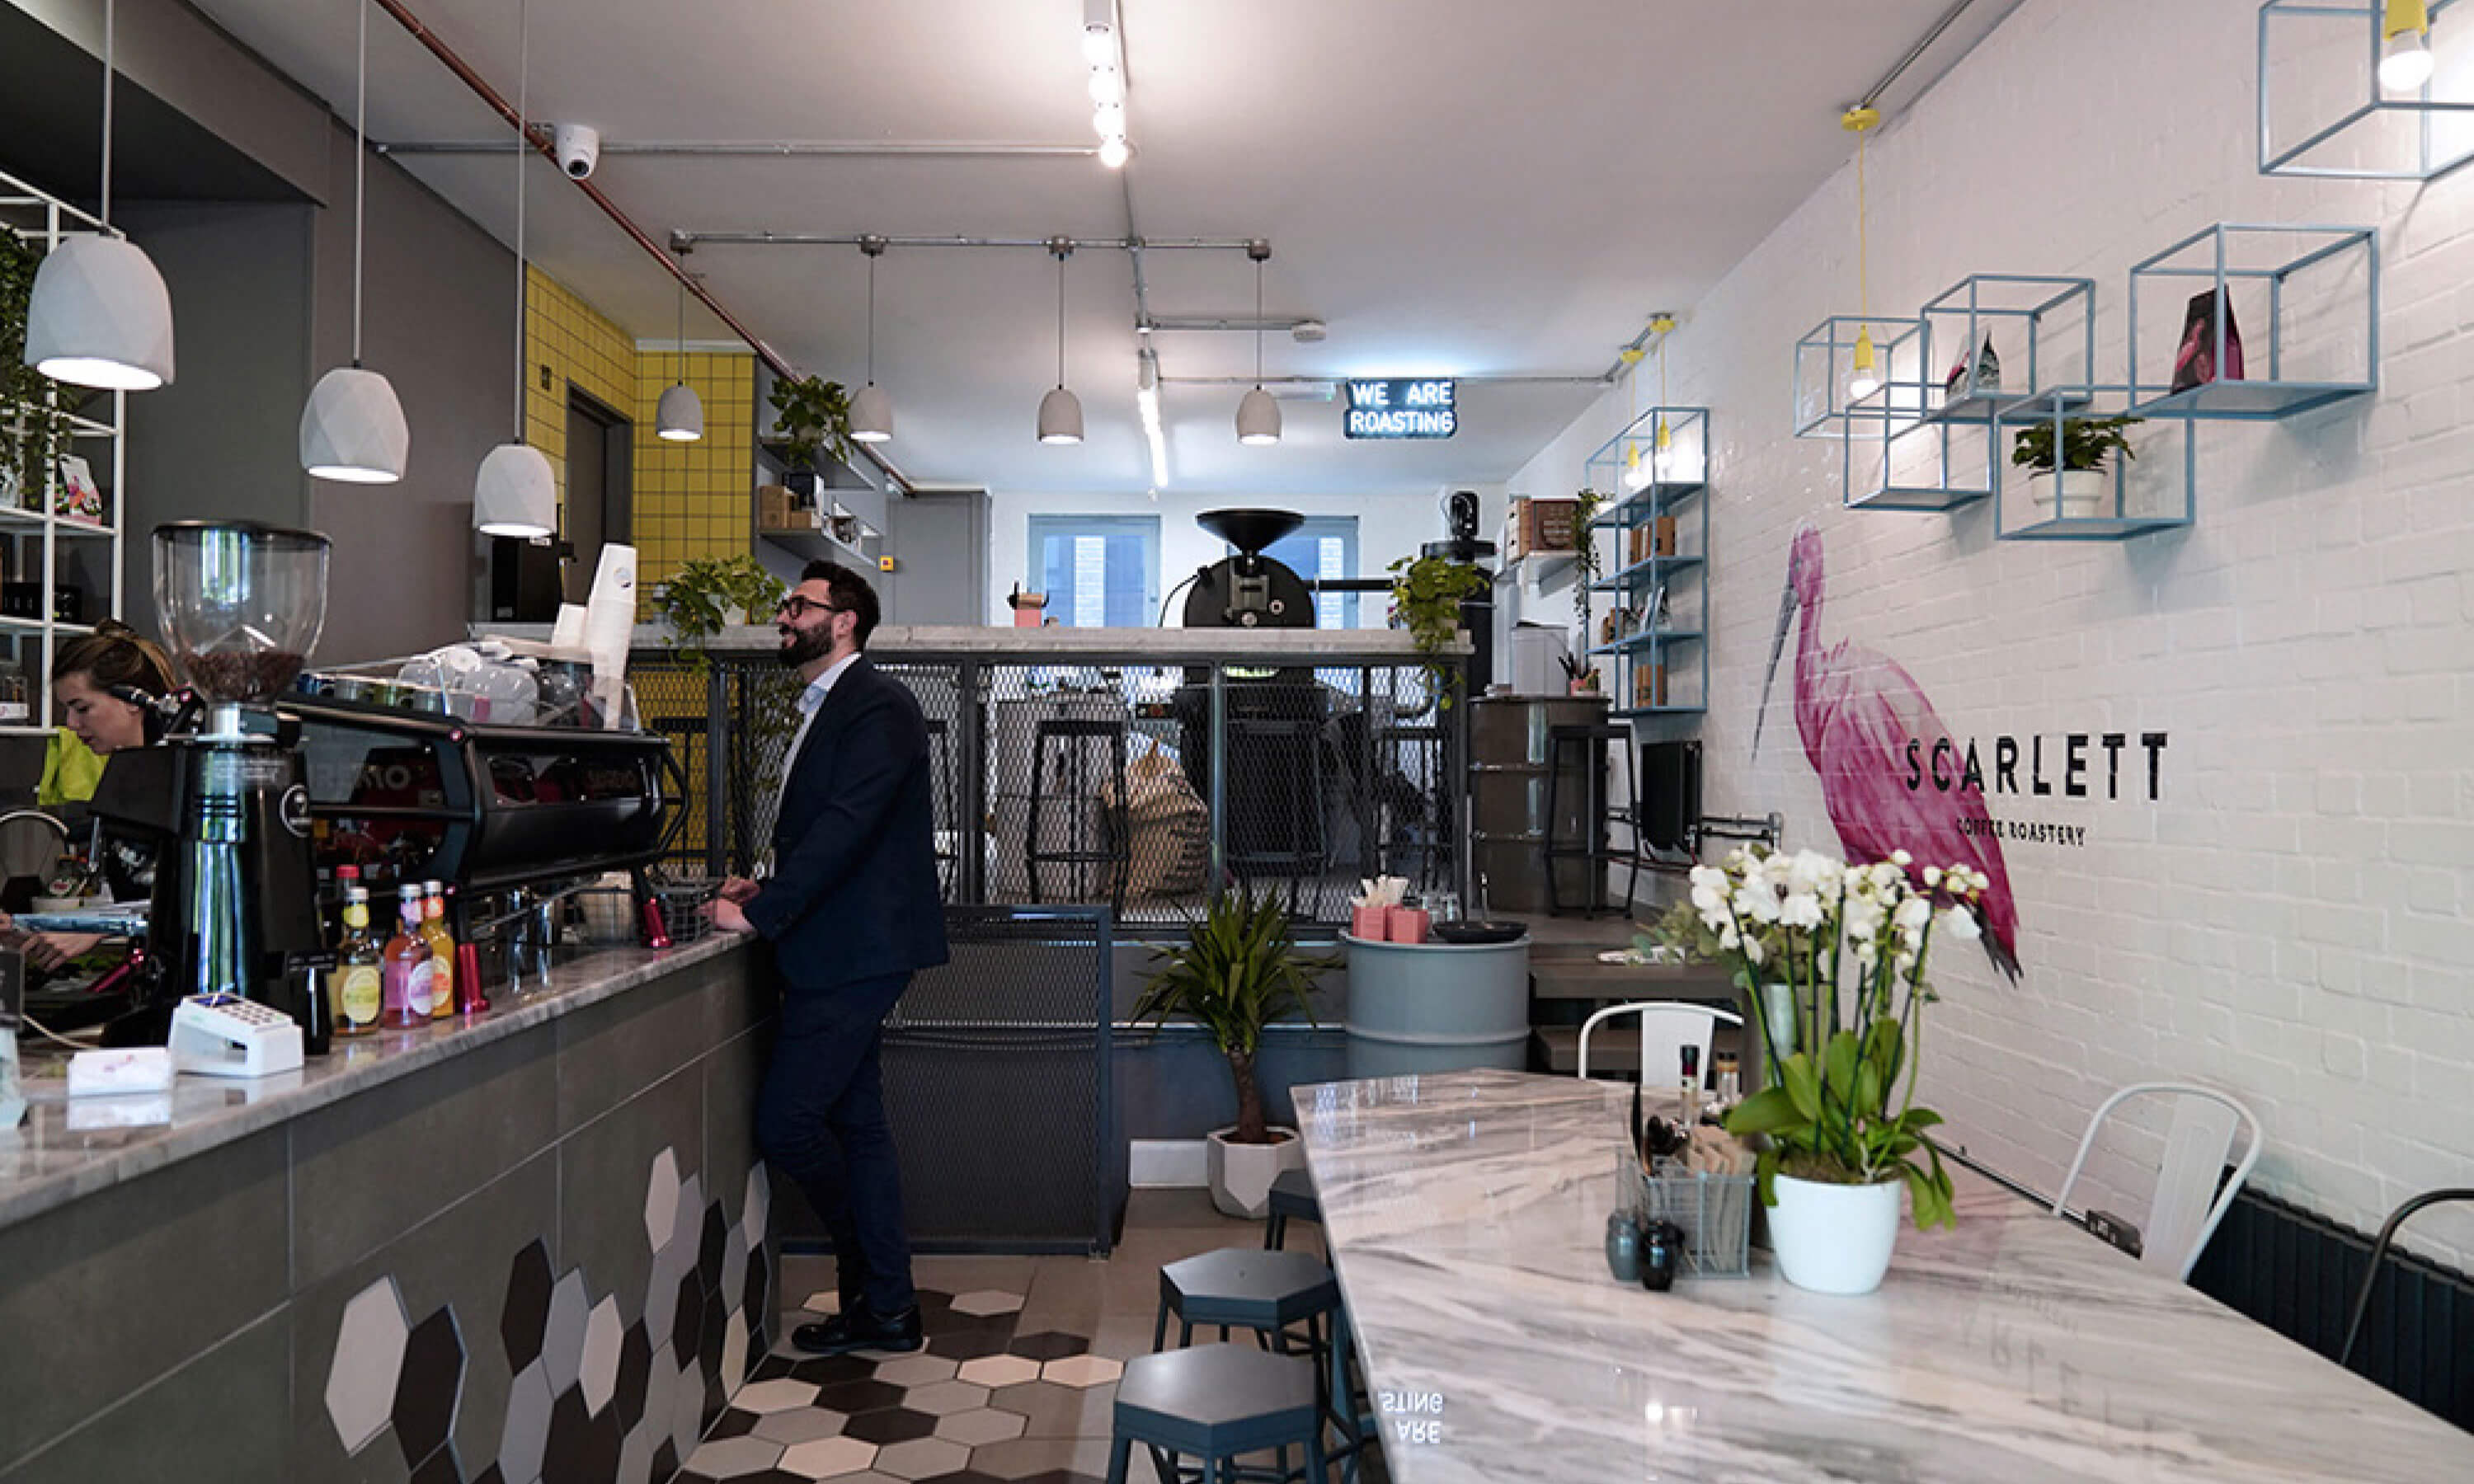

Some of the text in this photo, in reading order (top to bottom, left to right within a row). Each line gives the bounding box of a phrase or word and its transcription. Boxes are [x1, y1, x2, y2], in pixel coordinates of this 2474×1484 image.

[1352, 383, 1453, 405] WE ARE
[1350, 411, 1454, 433] ROASTING
[1906, 732, 2168, 800] SCARLETT
[1957, 817, 2085, 847] COFFEE ROASTERY
